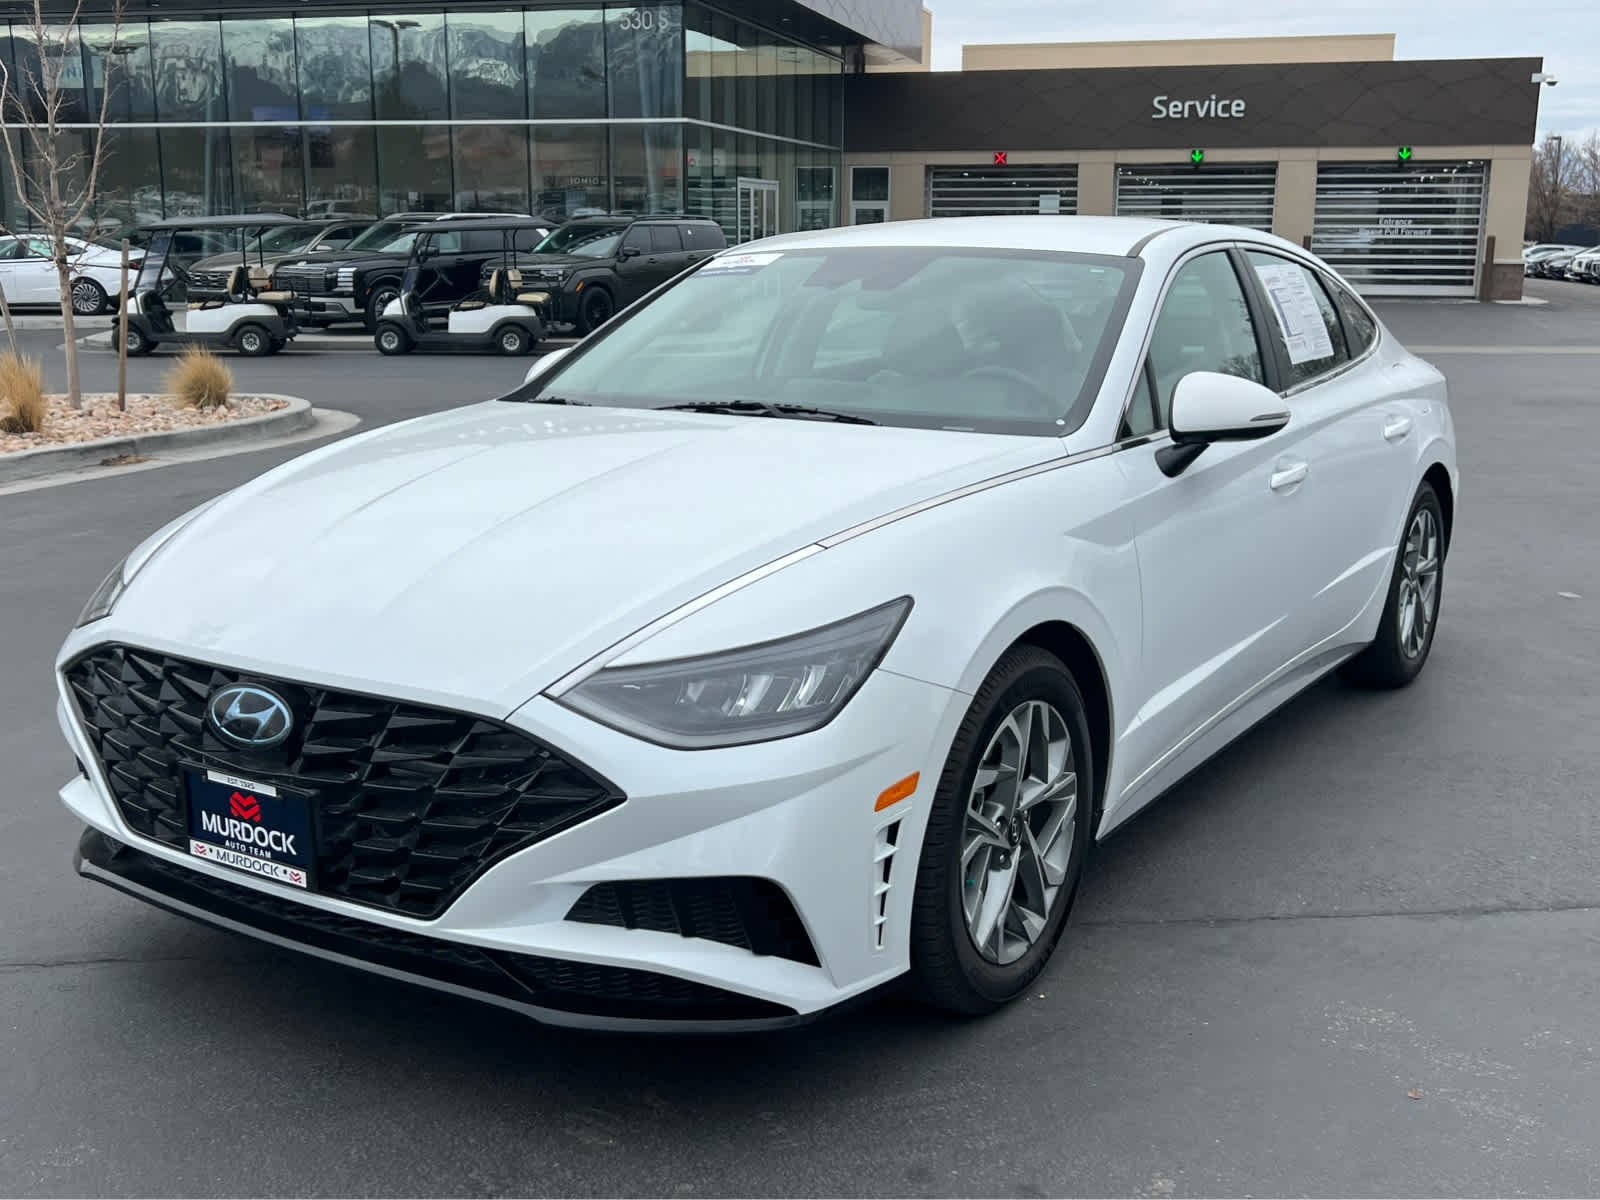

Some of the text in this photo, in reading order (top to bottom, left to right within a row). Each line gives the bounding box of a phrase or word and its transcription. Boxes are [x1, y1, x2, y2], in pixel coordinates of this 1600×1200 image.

[620, 10, 669, 30] 530 S
[1152, 94, 1246, 118] Service
[1379, 216, 1413, 226] Entrance
[1384, 226, 1400, 237] Pull
[1401, 226, 1432, 237] Forward
[201, 810, 297, 855] MURDOCK
[224, 840, 271, 859] AUTO TEAM
[216, 849, 280, 878] MURDOCK
